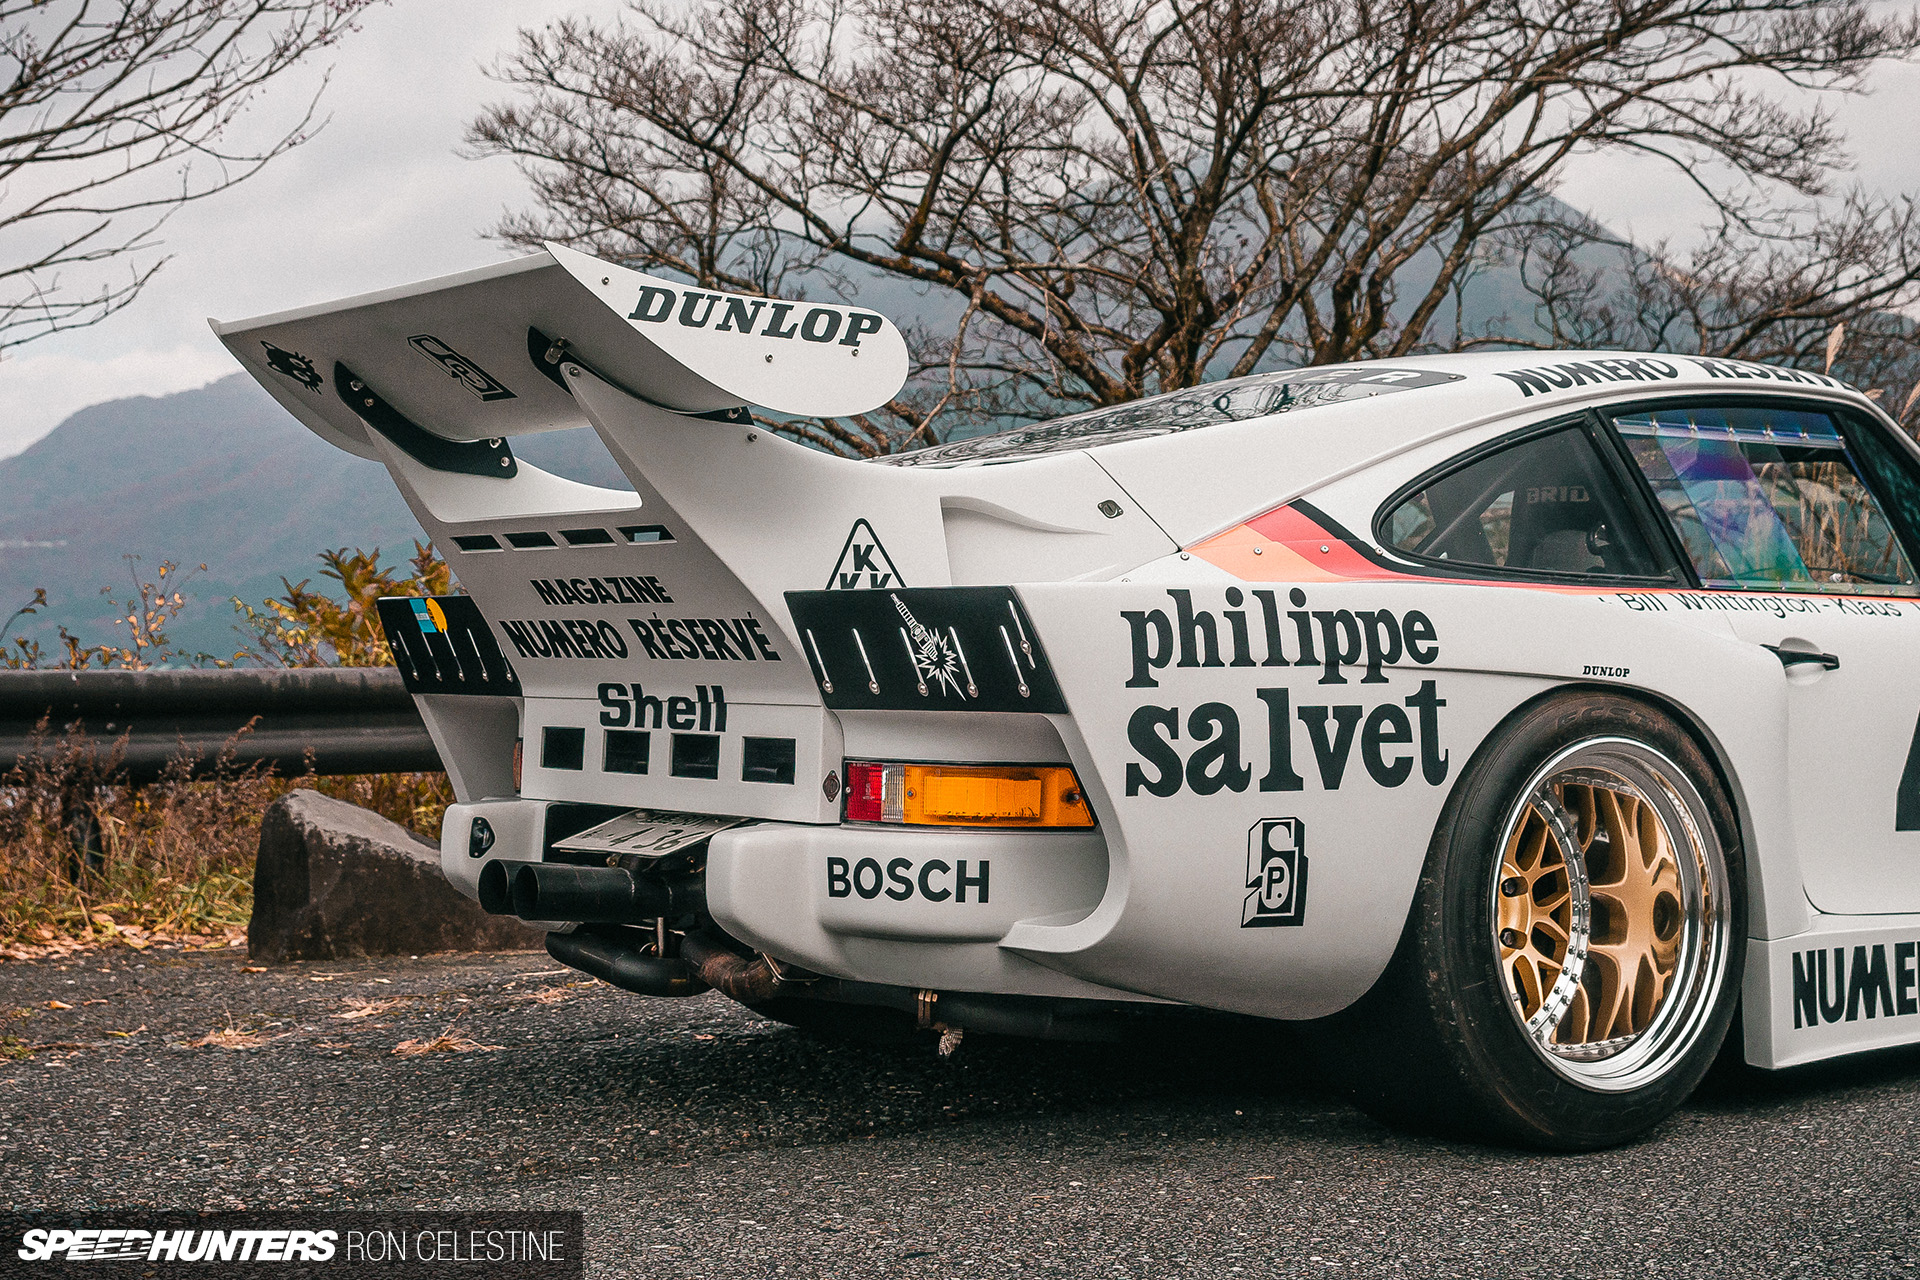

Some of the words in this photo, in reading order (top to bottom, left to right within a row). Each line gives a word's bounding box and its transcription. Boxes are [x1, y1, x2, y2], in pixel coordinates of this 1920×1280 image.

[628, 286, 883, 347] DUNLOP
[1492, 357, 1679, 398] NUMERO
[529, 576, 675, 605] MAGAZINE
[1615, 592, 1668, 611] Bill
[498, 619, 629, 659] NUMERO
[627, 611, 782, 661] RÉSERVÉ
[1120, 587, 1440, 689] philippe
[1582, 665, 1630, 678] DUNLOP
[597, 683, 727, 732] Shell
[1125, 680, 1449, 798] salvet
[827, 856, 990, 904] BOSCH
[1791, 941, 1920, 1030] NUME
